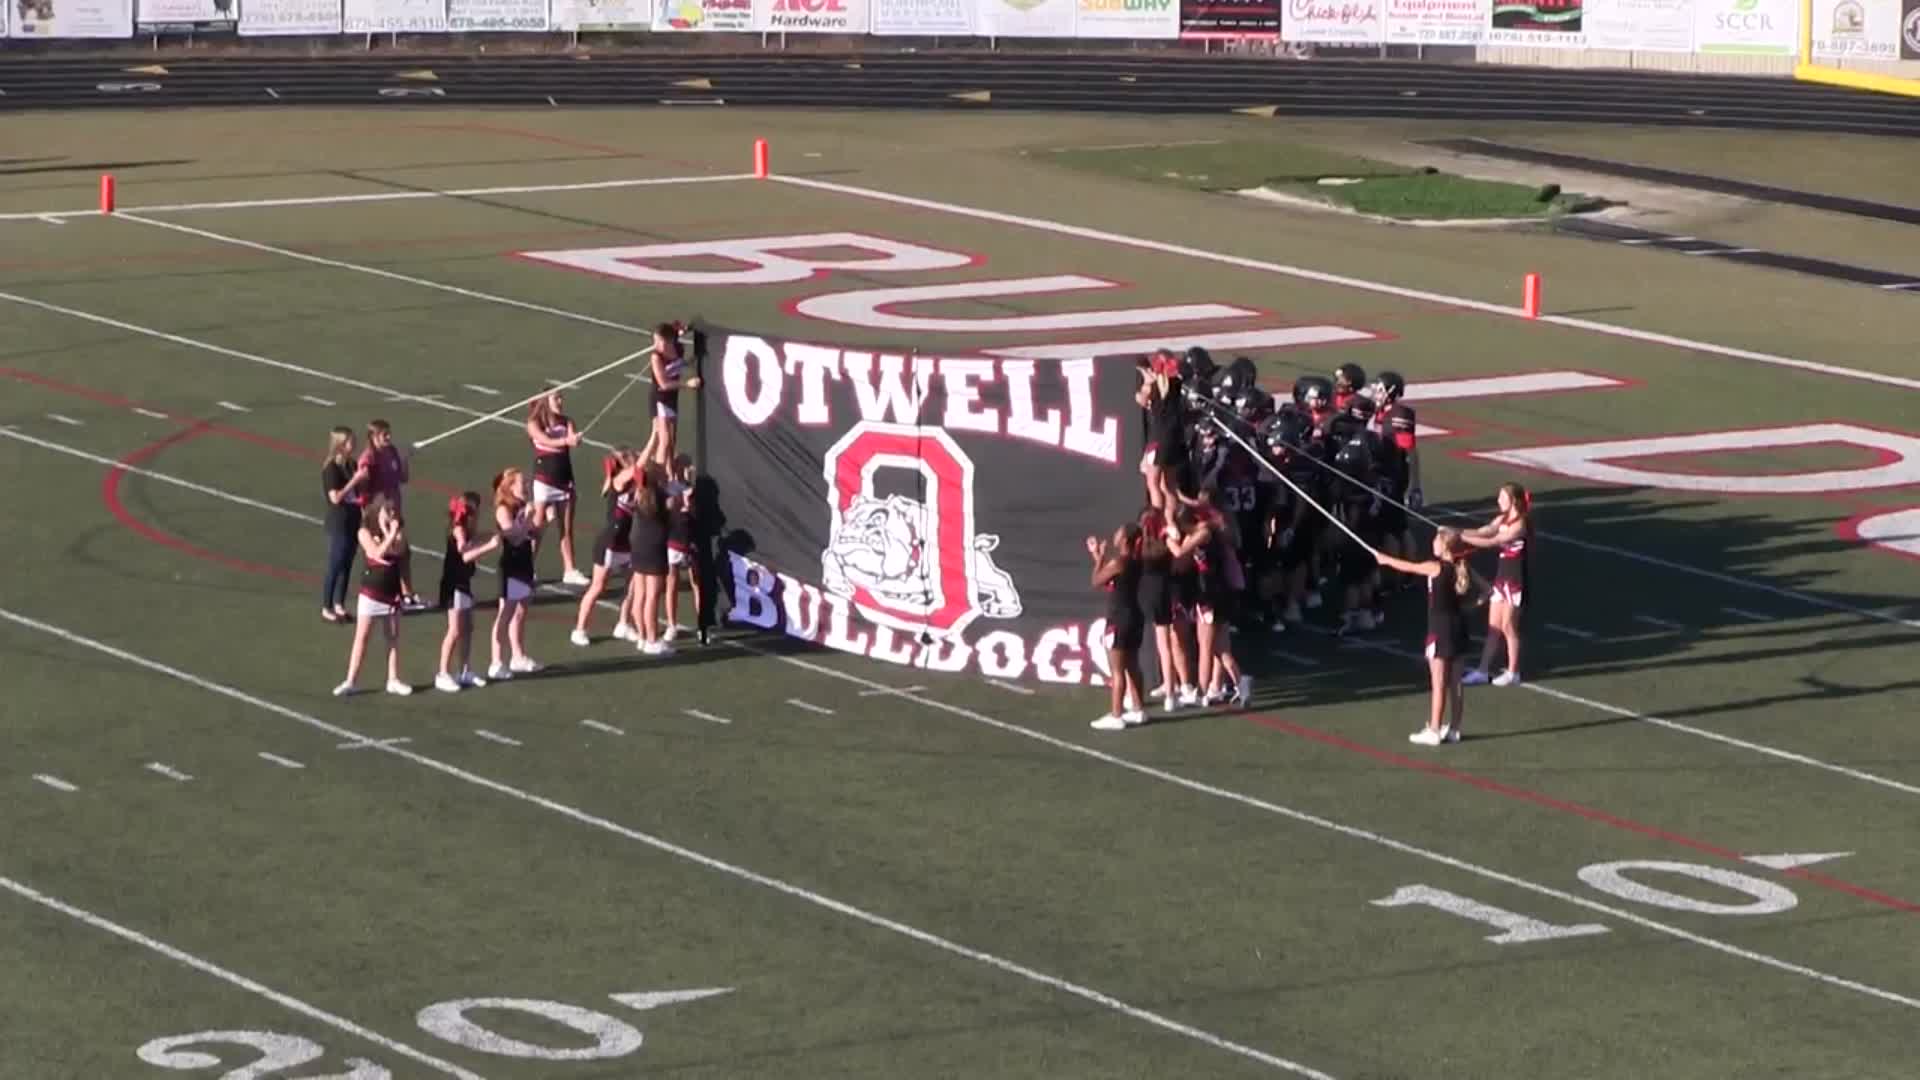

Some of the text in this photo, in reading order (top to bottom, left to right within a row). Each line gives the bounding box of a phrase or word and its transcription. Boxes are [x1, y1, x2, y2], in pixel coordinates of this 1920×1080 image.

[770, 14, 848, 27] Hardware
[1714, 13, 1774, 31] SCCR
[722, 335, 1119, 463] OTWELL
[728, 550, 1115, 687] BULLDOGS
